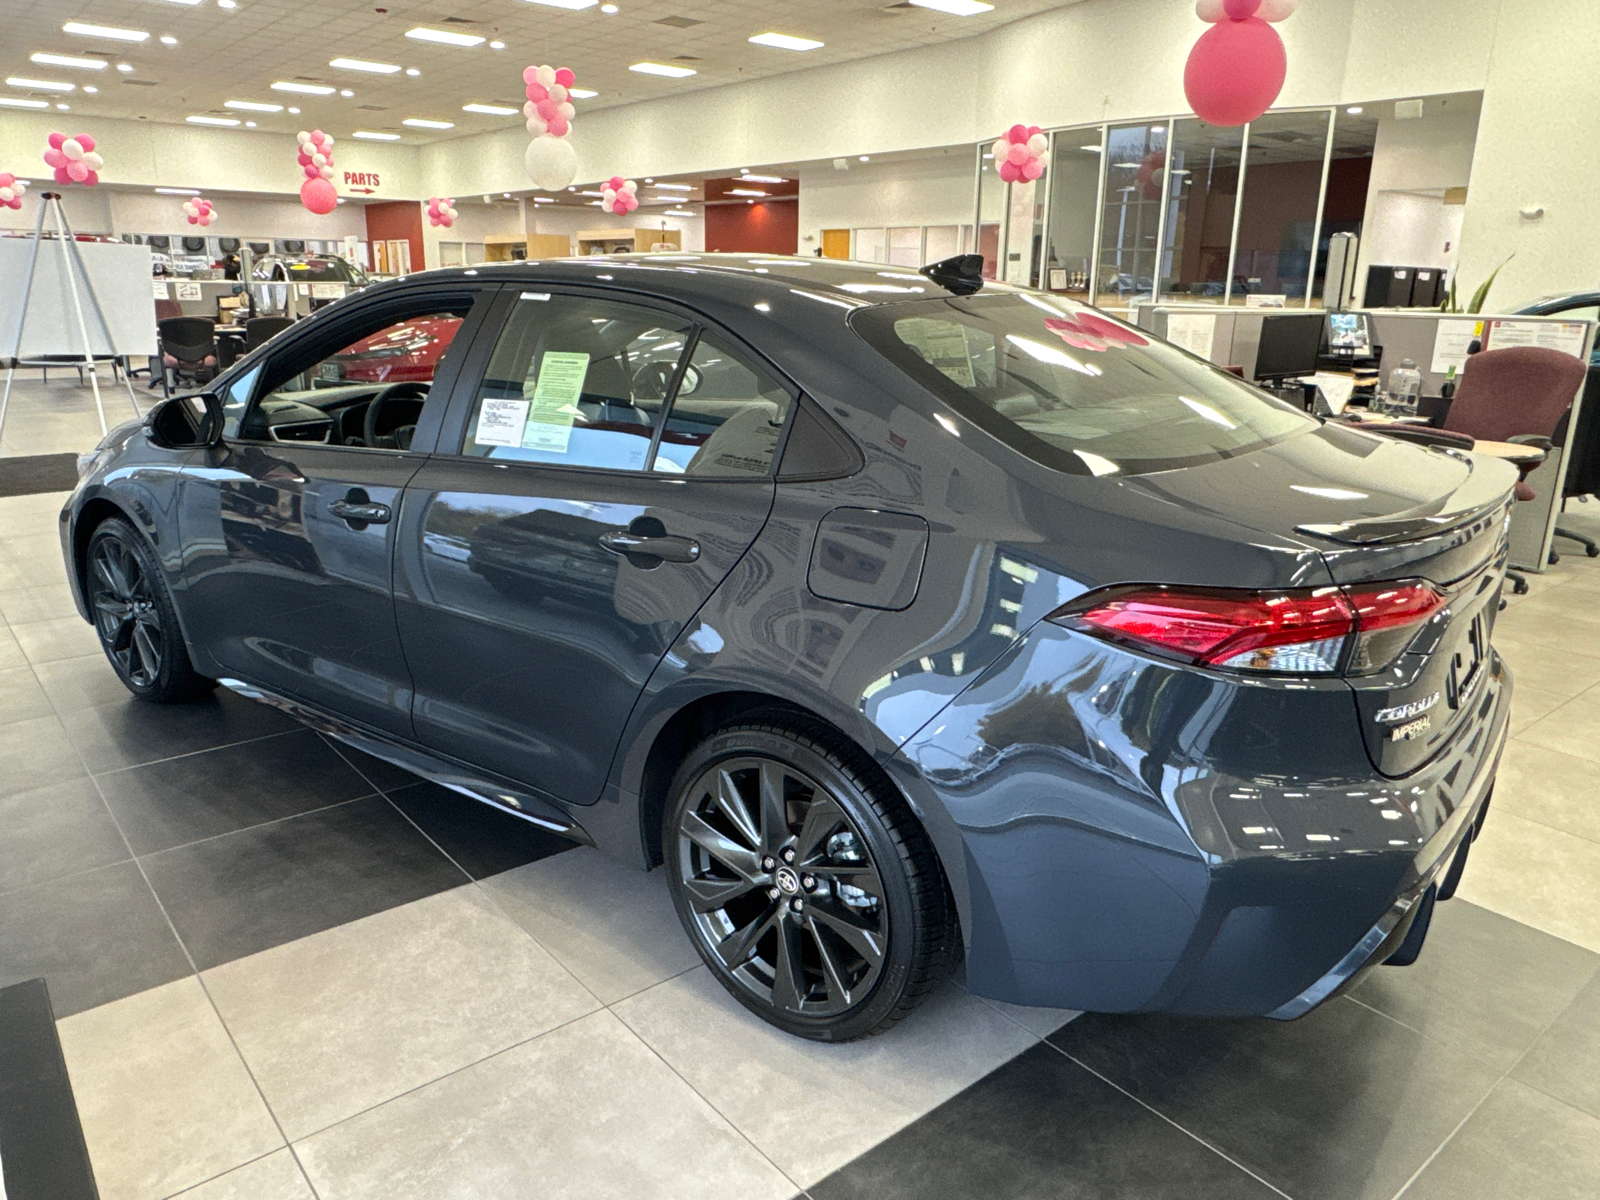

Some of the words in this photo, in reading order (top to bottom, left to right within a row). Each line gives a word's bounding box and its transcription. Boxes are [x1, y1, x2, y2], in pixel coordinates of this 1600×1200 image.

[343, 171, 380, 186] PARTS
[1374, 691, 1440, 722] COROLLA
[1392, 715, 1431, 742] IMPERIAL
